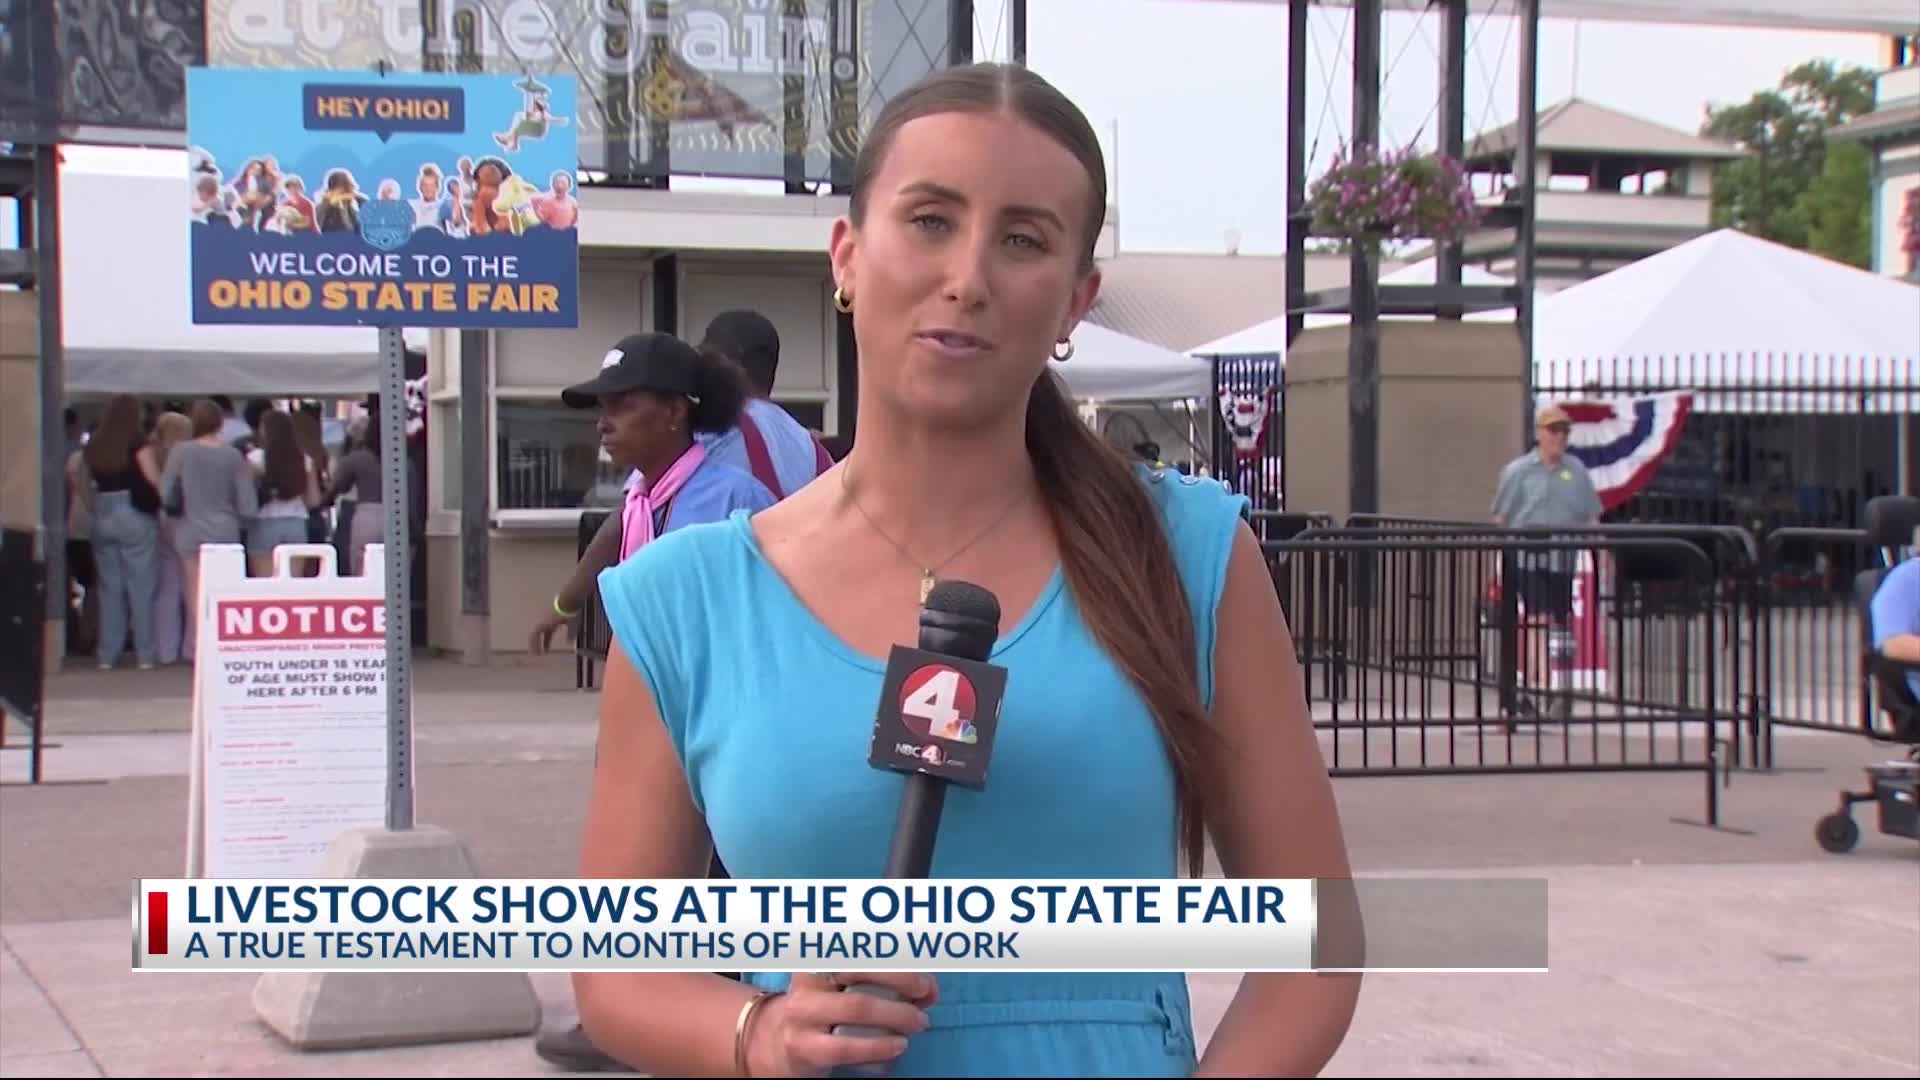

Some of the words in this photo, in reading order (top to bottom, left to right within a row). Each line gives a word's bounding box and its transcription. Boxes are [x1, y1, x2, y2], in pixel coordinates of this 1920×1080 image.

[230, 0, 344, 48] at
[383, 0, 560, 60] the
[316, 95, 369, 119] HEY
[374, 97, 450, 122] OHIO!
[249, 252, 402, 277] WELCOME
[412, 255, 453, 278] TO
[462, 255, 519, 279] THE
[208, 279, 313, 310] OHIO
[321, 280, 457, 312] STATE
[466, 283, 561, 314] FAIR
[223, 605, 386, 635] NOTICE
[223, 660, 274, 671] YOUTH
[278, 659, 329, 670] UNDER
[333, 658, 349, 669] 18
[227, 674, 247, 685] OF
[252, 674, 281, 684] AGE
[286, 673, 327, 683] MUST
[333, 672, 376, 682] SHOW
[246, 687, 287, 698] HERE
[290, 685, 338, 697] AFTER
[343, 685, 352, 696] 6
[355, 685, 378, 696] PM
[902, 669, 961, 742] 4
